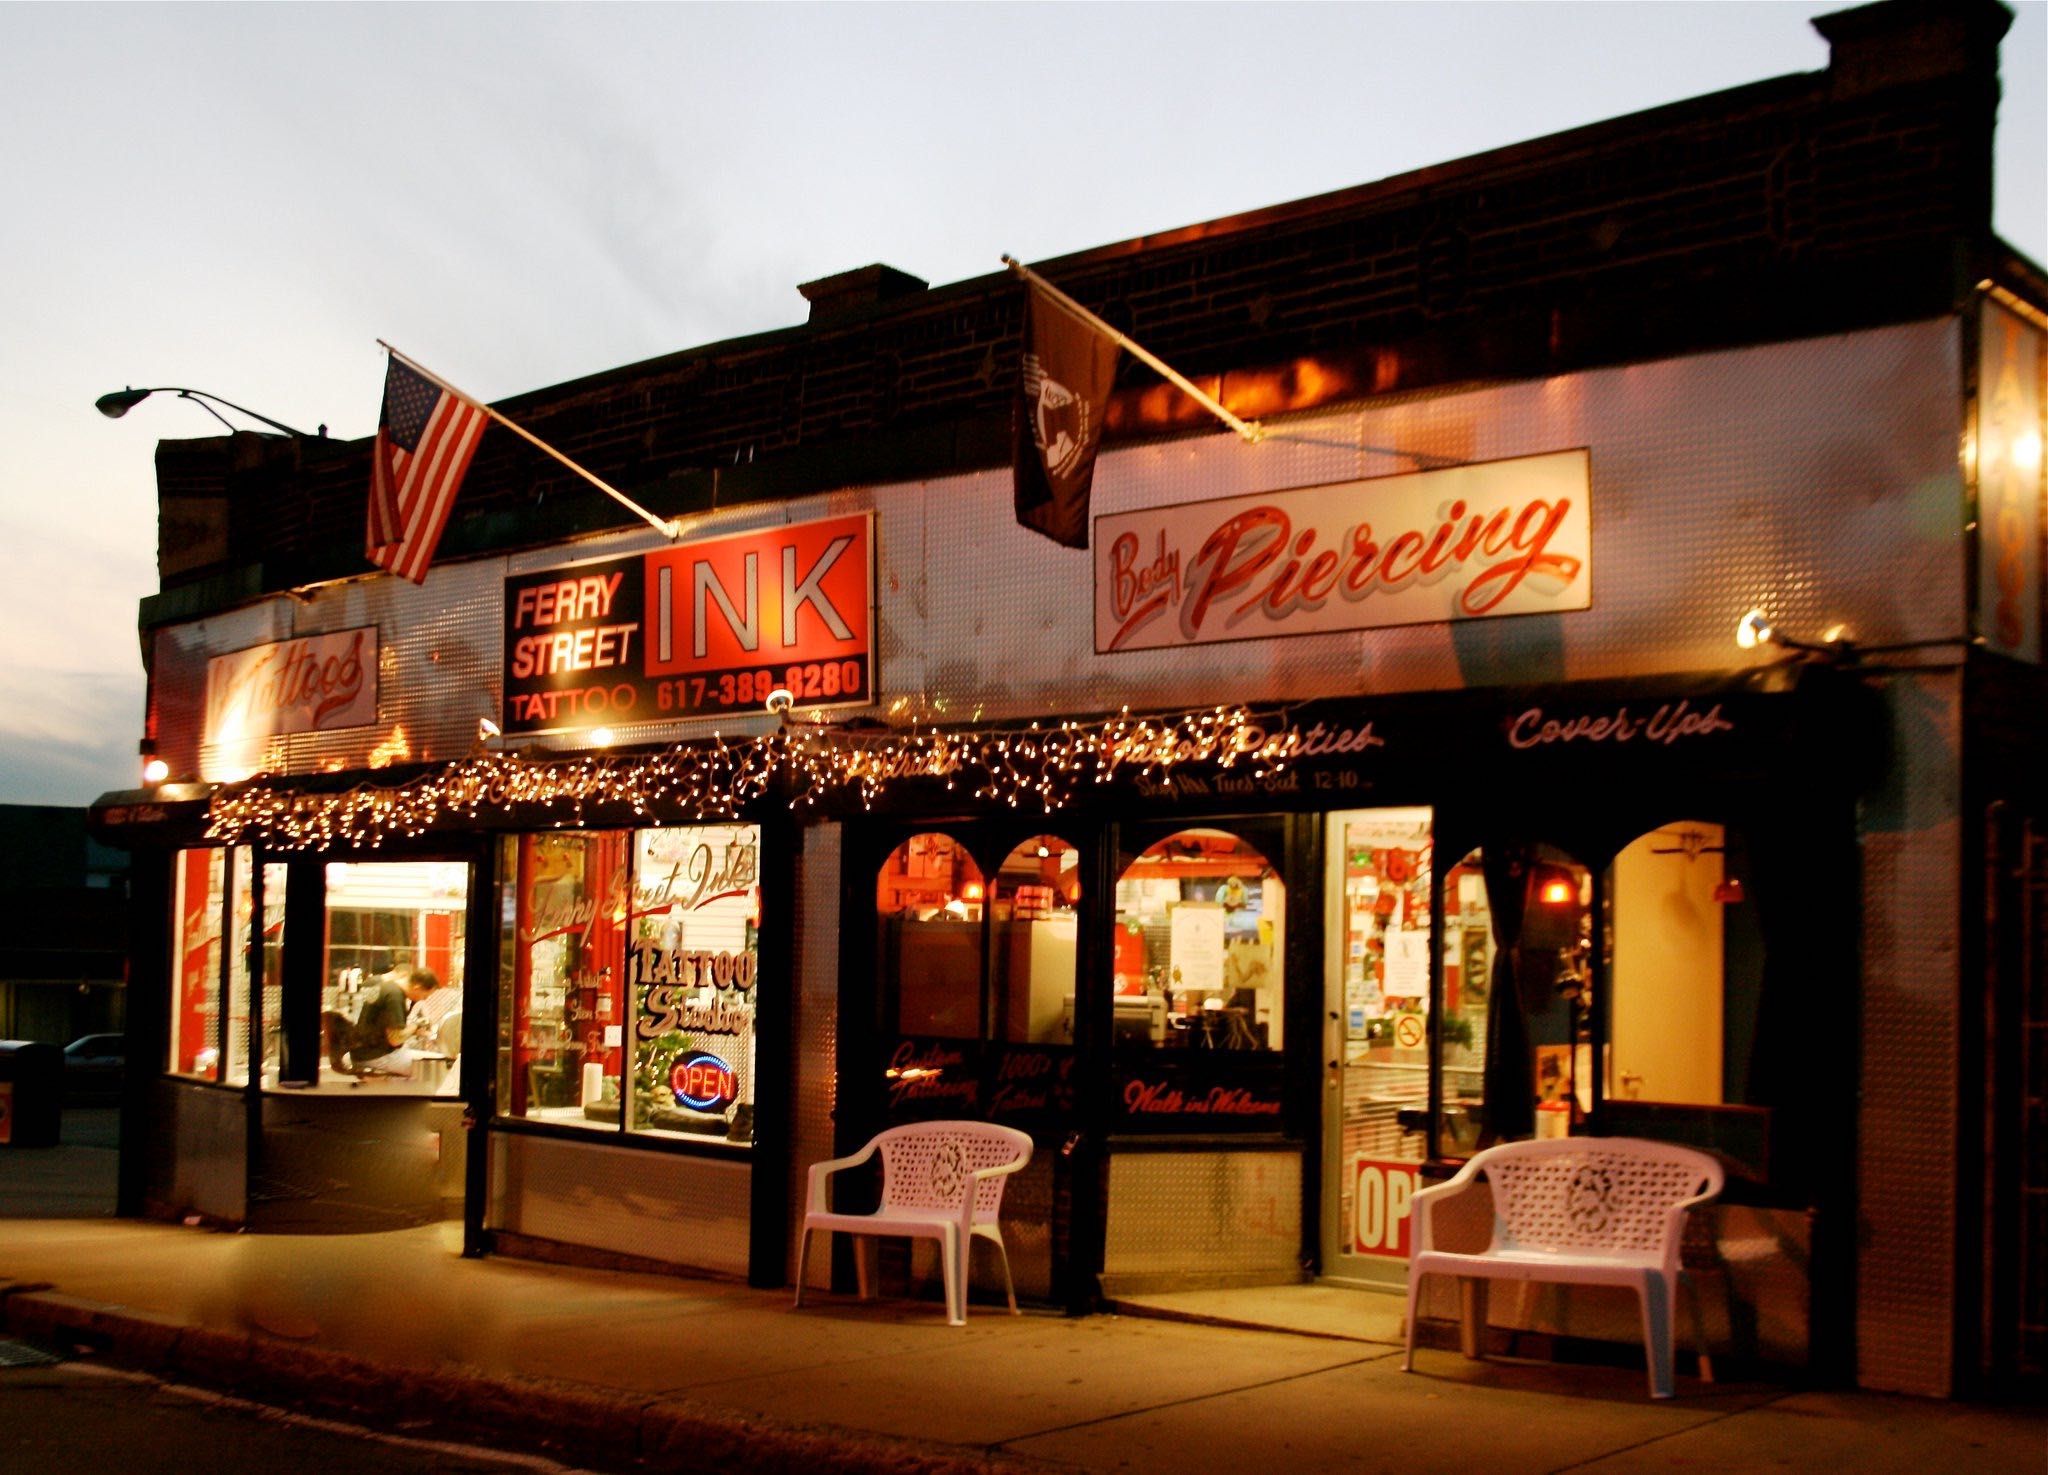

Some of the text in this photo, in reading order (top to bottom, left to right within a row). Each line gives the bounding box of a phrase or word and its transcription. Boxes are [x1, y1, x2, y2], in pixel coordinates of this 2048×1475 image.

[1111, 497, 1583, 640] Body Piercing
[513, 572, 624, 629] FERRY
[657, 535, 856, 663] INK
[512, 622, 639, 680] STREET
[509, 684, 637, 722] TATTOO
[656, 660, 861, 712] 617-389-8280
[1221, 722, 1385, 768] Parties
[1507, 699, 1735, 749] Cover-Ups
[601, 862, 682, 920] Street
[678, 843, 756, 911] Ink
[631, 938, 757, 992] TATTOO
[636, 985, 750, 1042] Studio
[672, 1064, 734, 1100] OPEN
[1123, 1079, 1184, 1115] Walk
[1207, 1085, 1282, 1115] Welcome
[1358, 1166, 1423, 1251] OP
